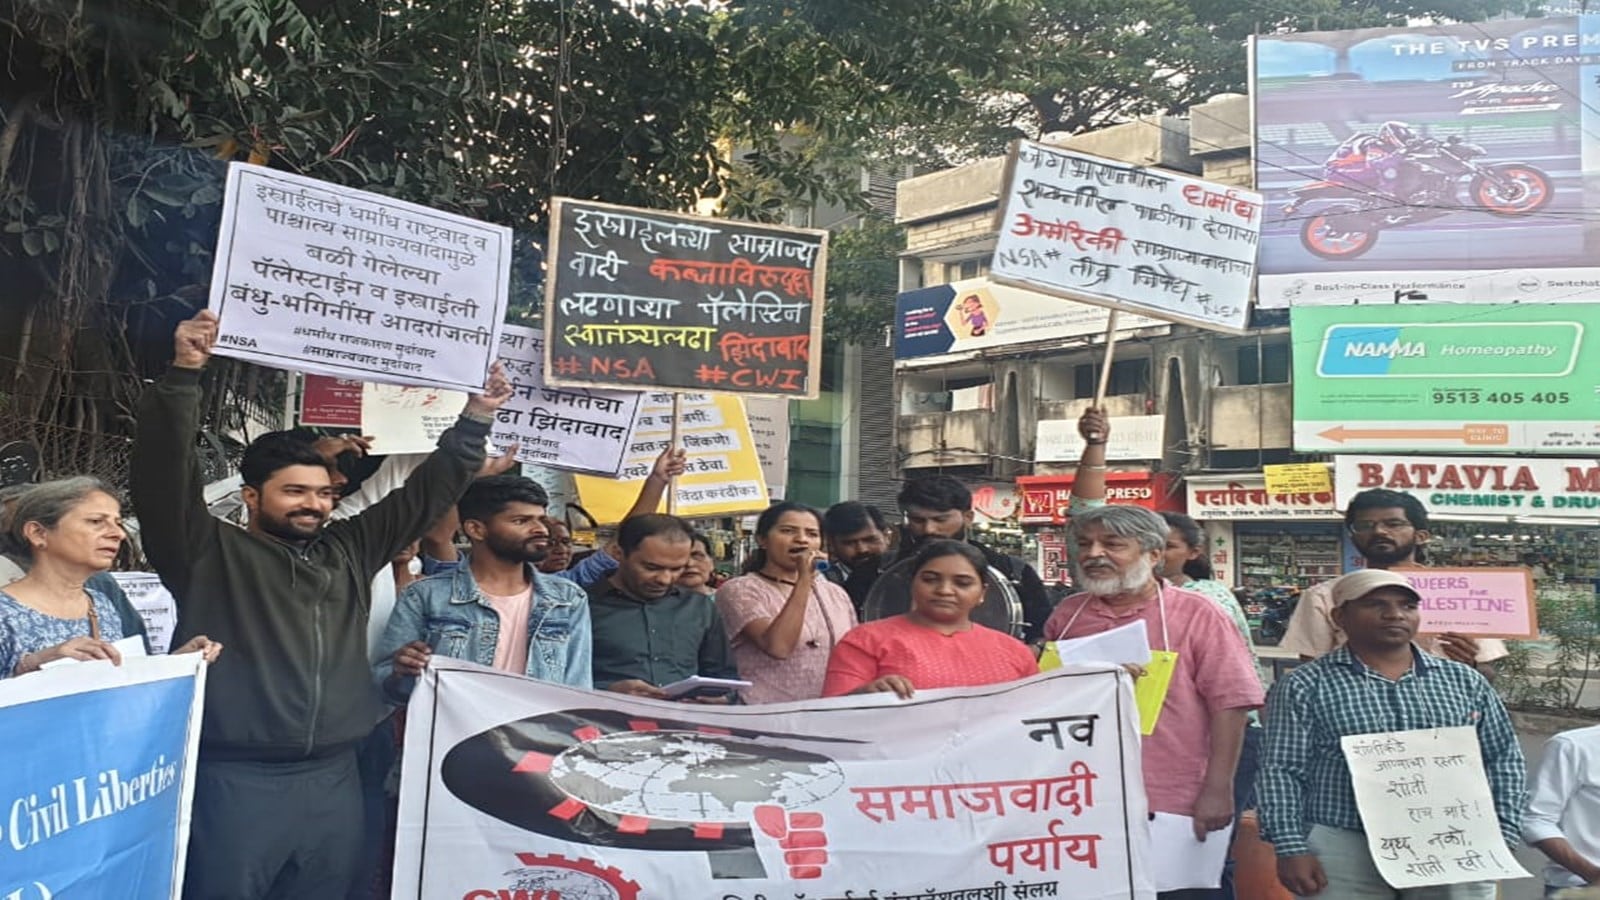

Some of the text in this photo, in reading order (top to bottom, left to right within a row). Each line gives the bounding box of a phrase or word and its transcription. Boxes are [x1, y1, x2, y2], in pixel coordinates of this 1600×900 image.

[1392, 42, 1444, 56] THE
[1458, 38, 1510, 53] TVS
[1458, 55, 1591, 70] FROM TRACK DAYS
[406, 217, 471, 250] राष्ट्रवाद
[474, 236, 488, 252] व
[251, 256, 364, 297] पॅलेस्टाईन
[370, 282, 389, 301] व
[306, 242, 442, 286] बळी गेलेल्या
[219, 334, 258, 349] #NSA
[381, 311, 493, 347] आदरांजली
[1344, 337, 1558, 360] NAMMA Homeopathy
[541, 386, 624, 414] जनतेचा
[1432, 391, 1481, 404] 9513
[1487, 391, 1525, 404] 405
[1532, 391, 1570, 404] 405
[528, 406, 627, 442] झिंदाबाद
[1357, 463, 1539, 493] BATAVIA
[1430, 493, 1525, 508] CHEMIST
[1531, 495, 1546, 508] &
[1022, 714, 1099, 750] नव
[9, 754, 177, 851] Civil Liberties
[850, 760, 1099, 824] समाजवादी
[987, 818, 1103, 875] पर्याय
